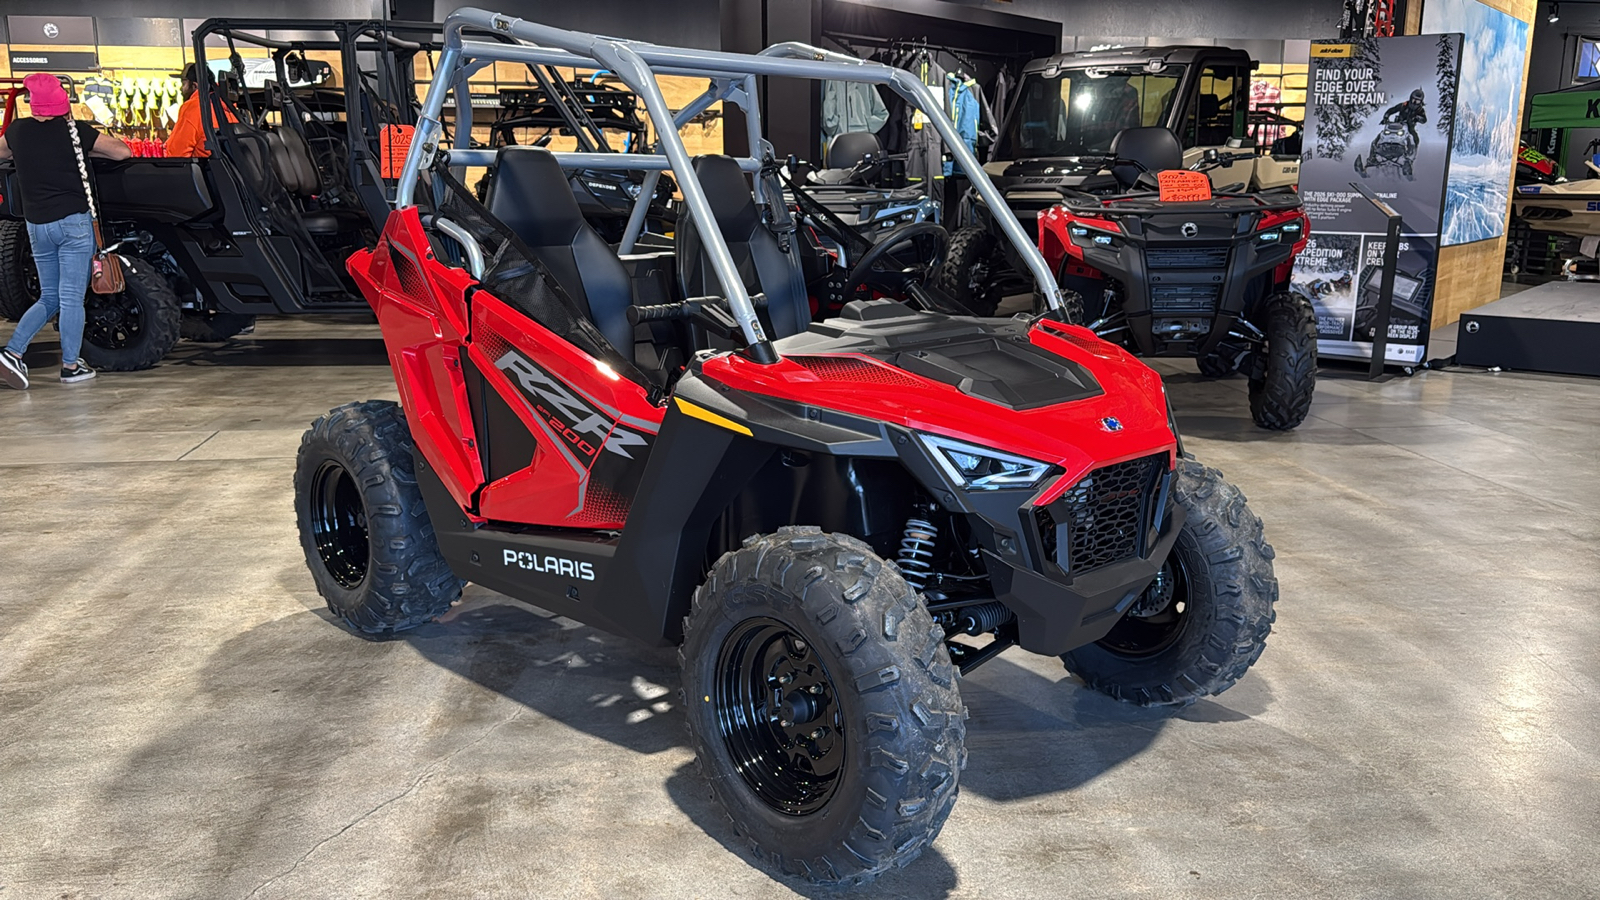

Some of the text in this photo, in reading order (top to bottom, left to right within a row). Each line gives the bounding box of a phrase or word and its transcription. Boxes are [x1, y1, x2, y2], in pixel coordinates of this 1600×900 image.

[1315, 68, 1373, 80] FIND YOUR
[1314, 80, 1375, 93] EDGE OVER
[1313, 92, 1388, 105] THE TERRAIN.
[589, 182, 617, 191] DEFENDER
[494, 350, 649, 460] RZR
[548, 416, 597, 457] 200
[503, 548, 596, 581] POLARIS
